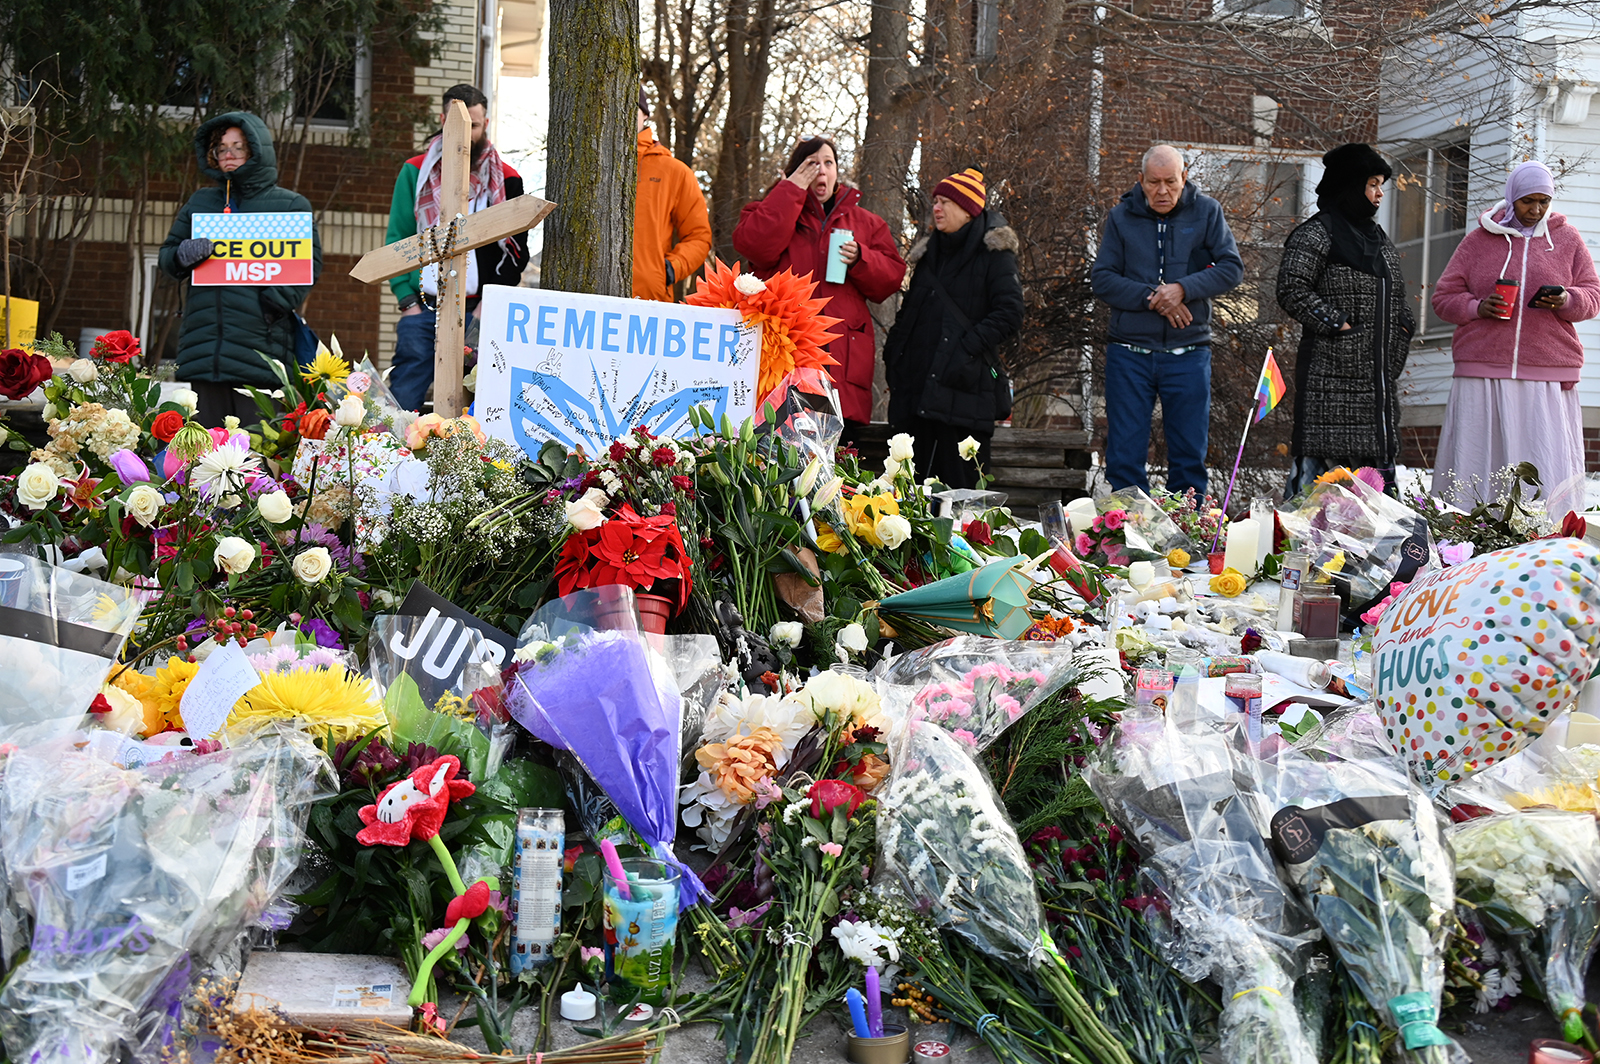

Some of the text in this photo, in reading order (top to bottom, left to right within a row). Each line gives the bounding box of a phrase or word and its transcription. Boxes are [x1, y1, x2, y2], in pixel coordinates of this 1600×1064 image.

[212, 241, 302, 258] CE OUT
[225, 262, 282, 281] MSP
[506, 302, 740, 363] REMEMBER
[536, 361, 562, 379] Got
[546, 348, 563, 370] We
[563, 418, 619, 442] BE REMEMBERE
[566, 409, 606, 428] YOU WILL
[1390, 577, 1470, 634] LOVE
[1398, 617, 1440, 645] and
[389, 606, 507, 692] JUS
[1378, 635, 1452, 695] HUGS
[650, 940, 663, 957] DE
[648, 959, 661, 982] LUZ
